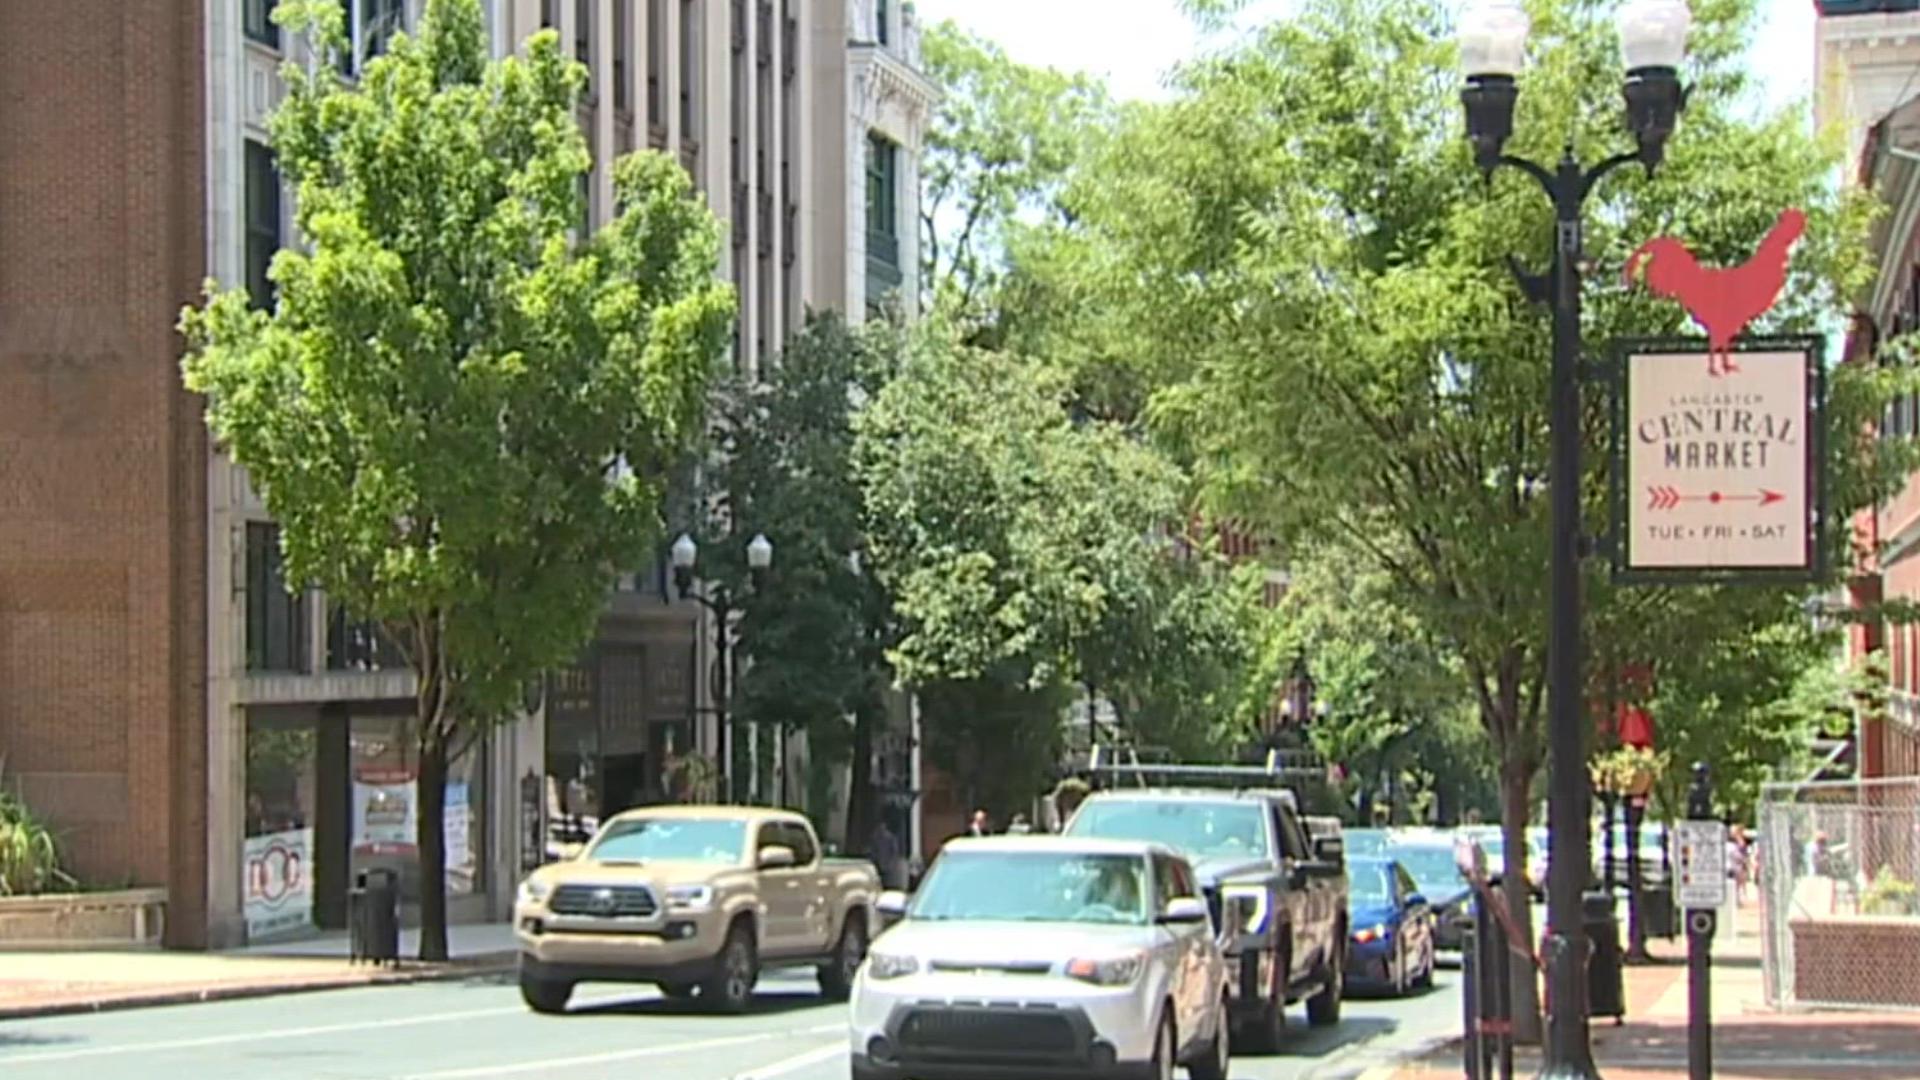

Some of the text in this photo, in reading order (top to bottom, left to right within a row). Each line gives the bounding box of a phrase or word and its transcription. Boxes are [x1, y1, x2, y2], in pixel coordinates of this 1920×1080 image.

[1669, 394, 1764, 406] LANCASTER
[1638, 408, 1796, 445] CENTRAL
[1664, 441, 1768, 468] MARKET
[1648, 525, 1787, 539] TUE FRI SAT
